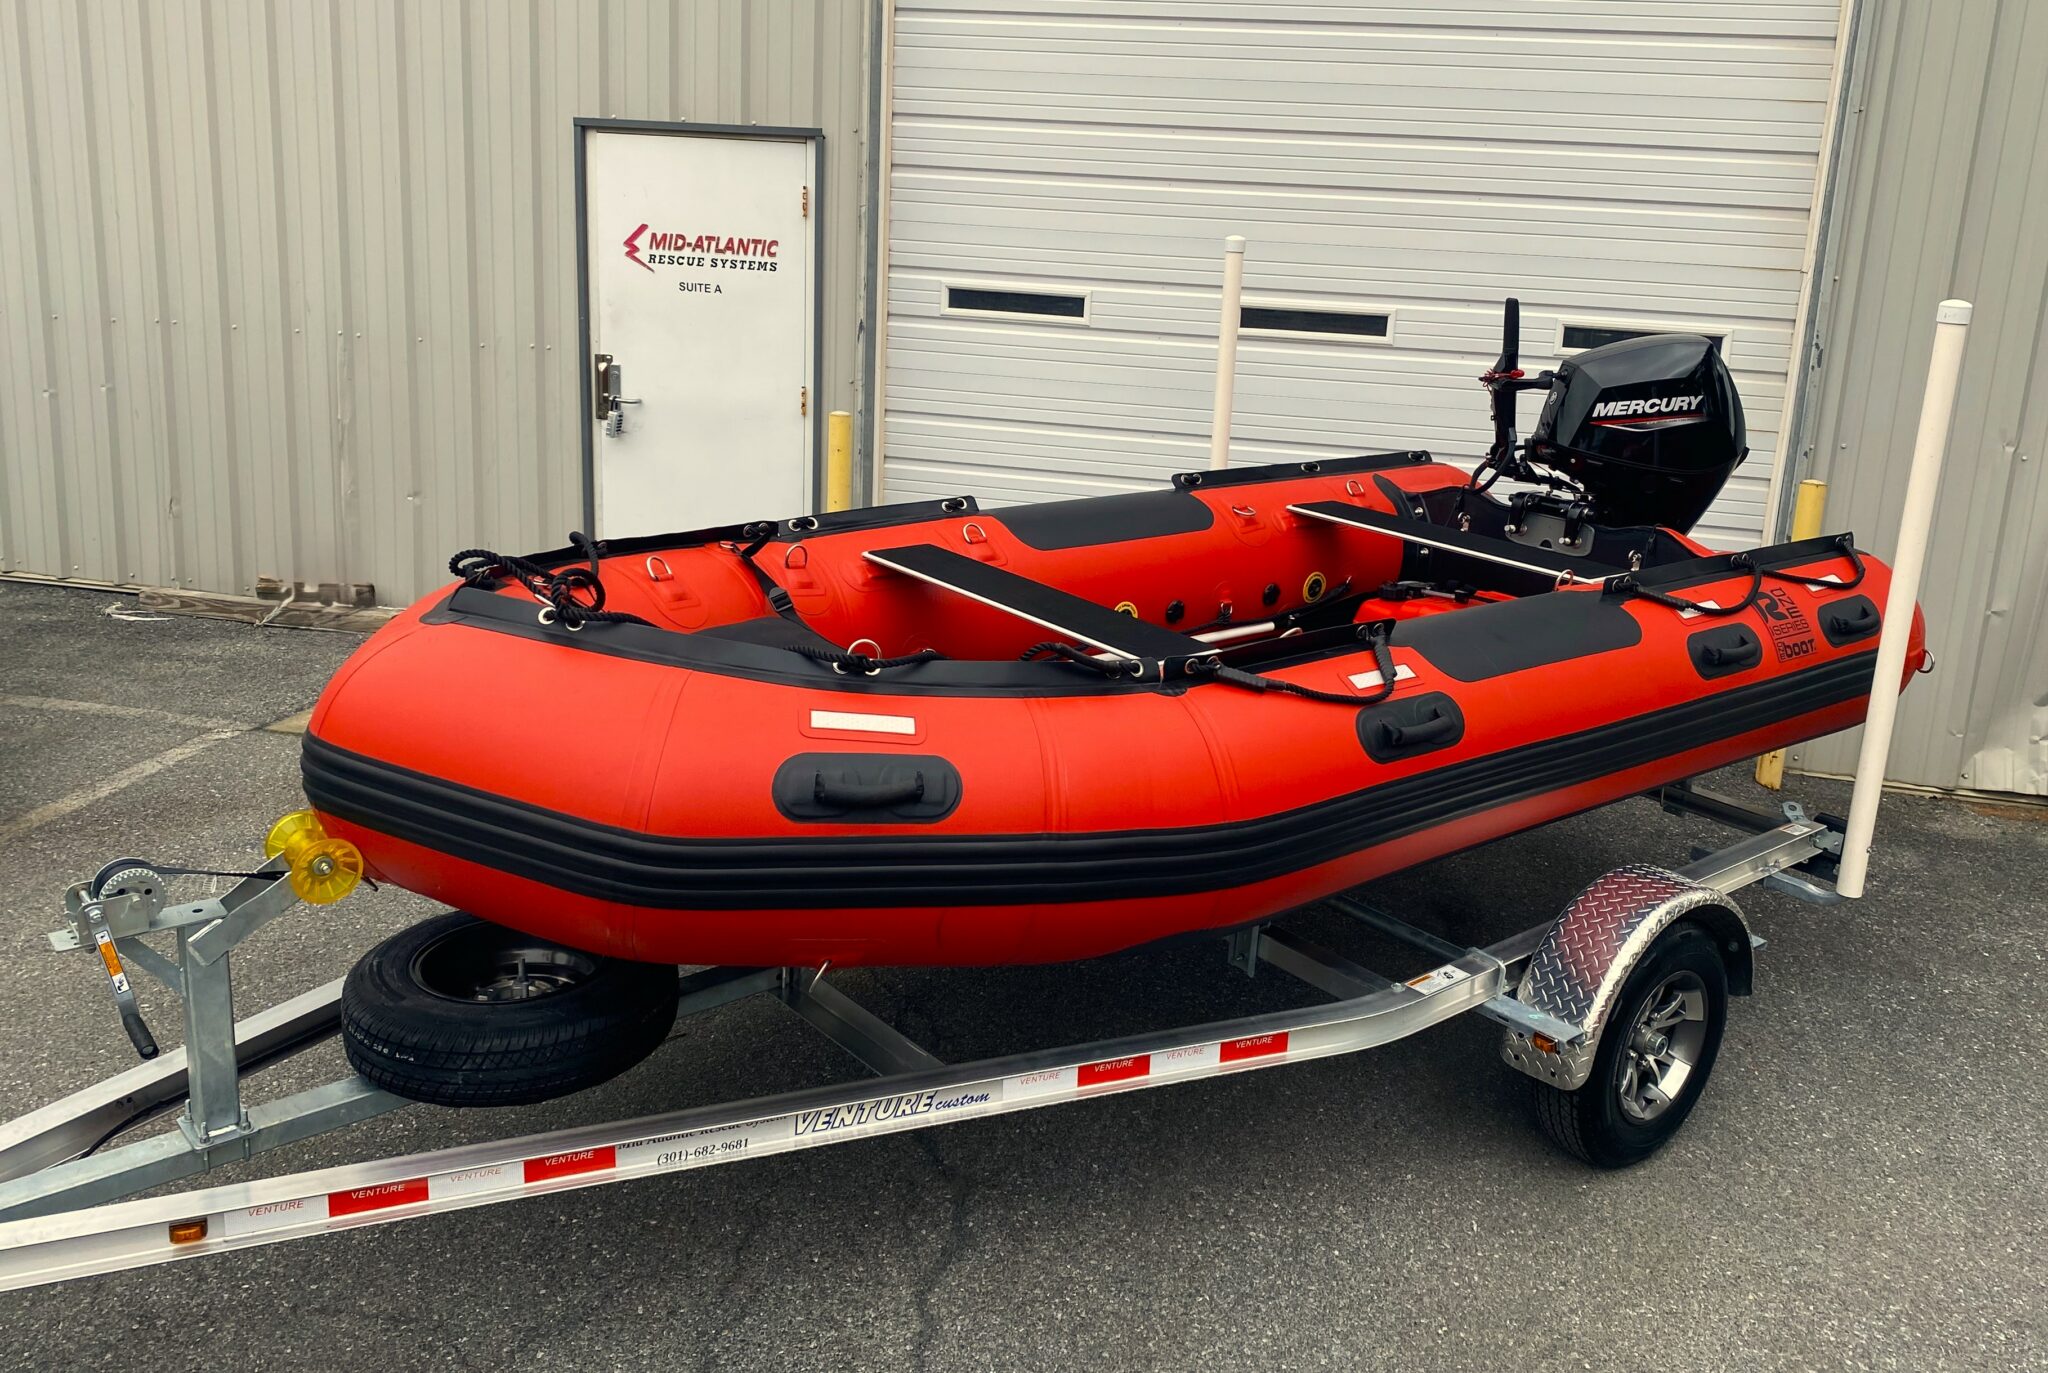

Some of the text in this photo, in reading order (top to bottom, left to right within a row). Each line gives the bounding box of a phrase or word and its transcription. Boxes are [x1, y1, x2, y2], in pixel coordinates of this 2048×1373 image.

[648, 232, 779, 258] MID-ATLANTIC
[648, 254, 778, 272] RESCUE SYSTEMS
[679, 282, 722, 294] SUITE A
[1592, 395, 1704, 417] MERCURY
[1236, 1036, 1274, 1049] VENTURE
[1166, 1047, 1205, 1060] VENTURE
[1094, 1058, 1134, 1073] VENTURE
[1020, 1071, 1061, 1085] VENTURE
[795, 1090, 990, 1136] VENTURE custom
[545, 1150, 594, 1166] VENTURE
[657, 1138, 750, 1166] (301)-682-9681
[450, 1168, 503, 1182] VENTURE
[351, 1183, 405, 1200] VENTURE
[248, 1200, 304, 1217] VENTURE
